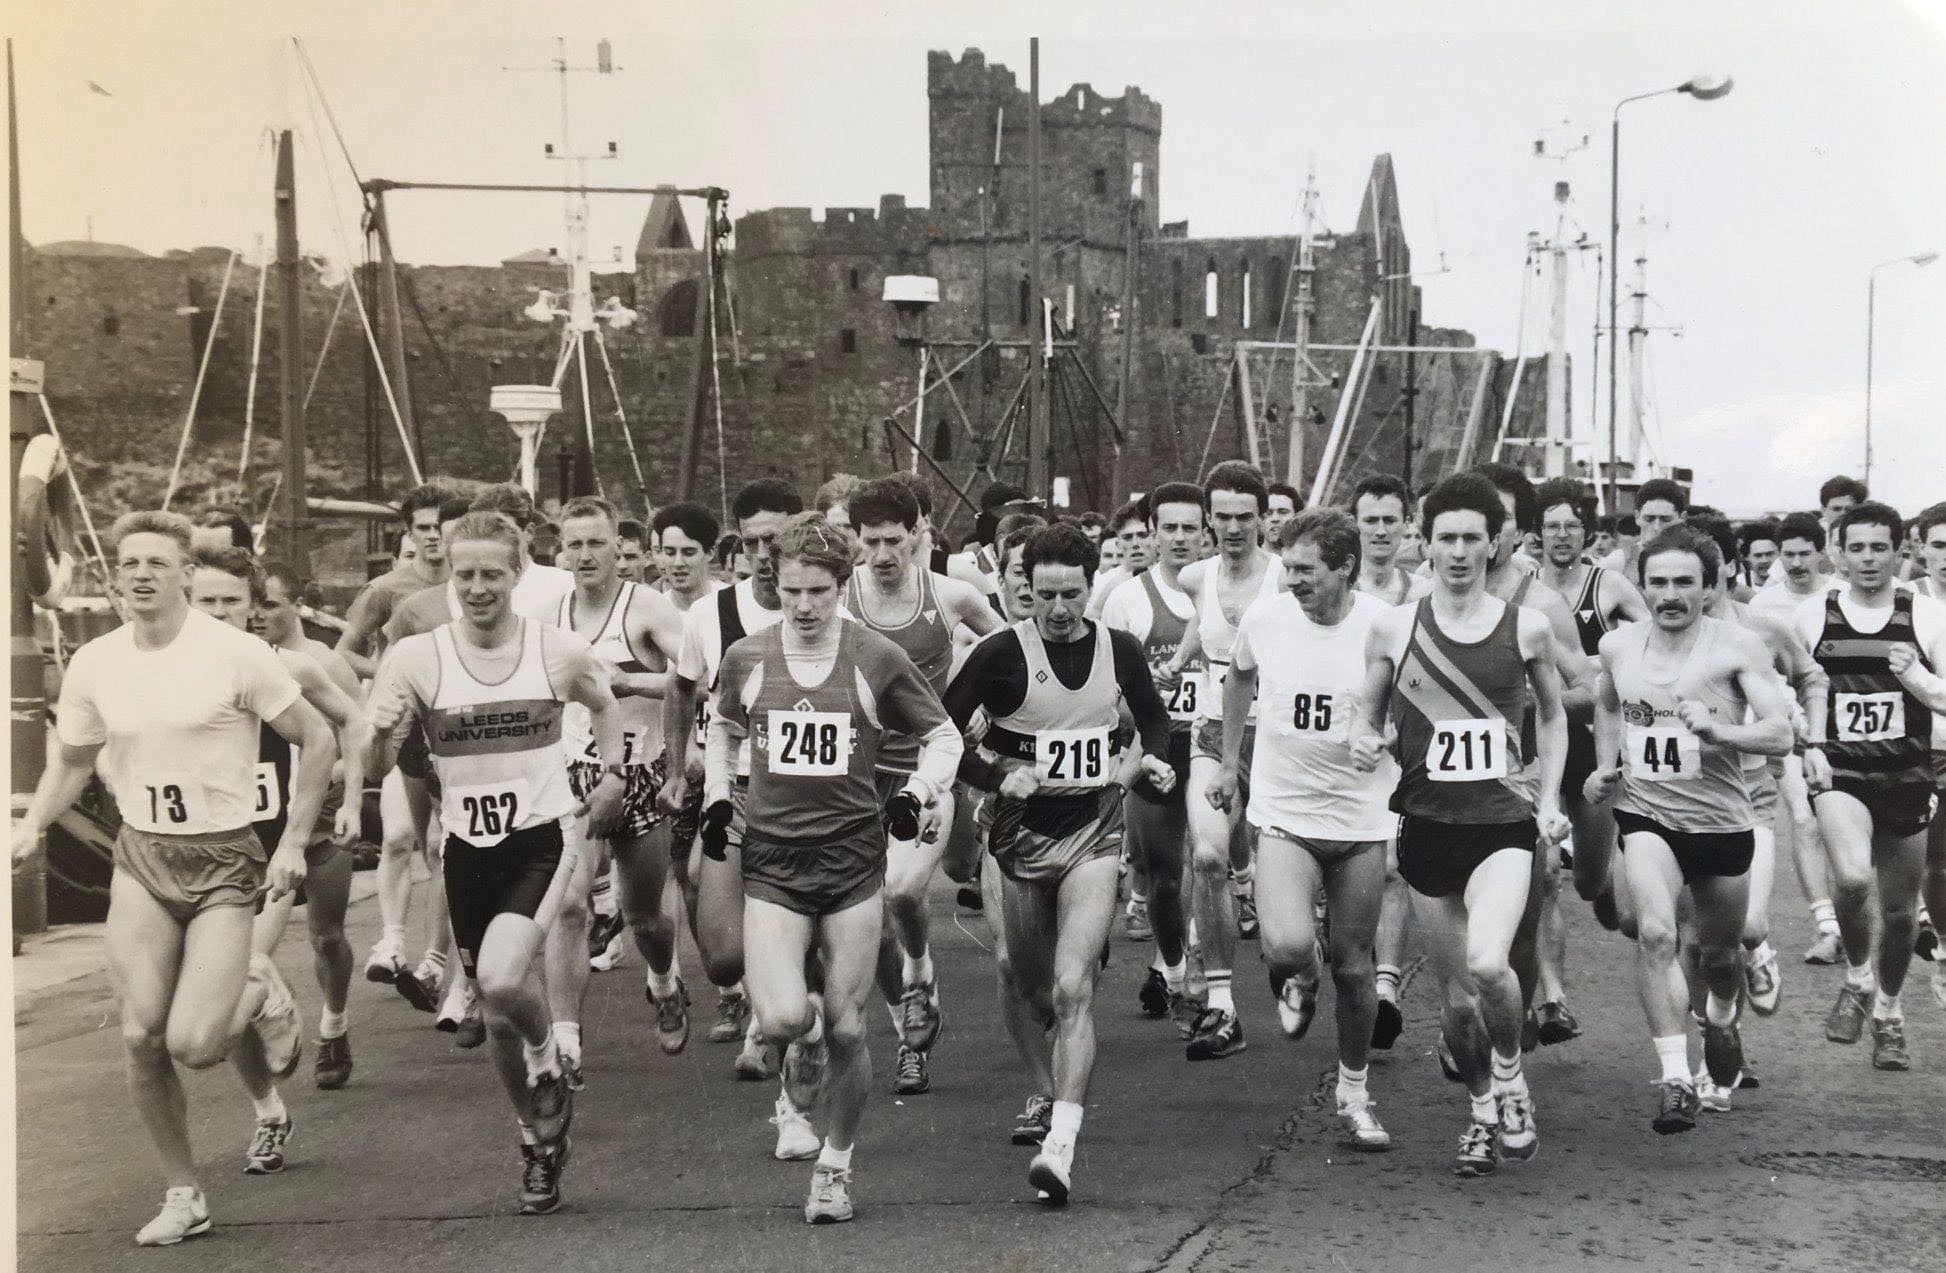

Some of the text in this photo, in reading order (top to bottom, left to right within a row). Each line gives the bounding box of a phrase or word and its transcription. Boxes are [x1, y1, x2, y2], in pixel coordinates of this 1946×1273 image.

[438, 721, 552, 742] UNIVERSITY
[461, 711, 529, 727] LEEDS
[1293, 693, 1332, 732] 85
[1846, 701, 1895, 734] 257
[780, 721, 838, 766] 248
[1048, 738, 1101, 779] 219
[1438, 730, 1492, 771] 211
[1644, 736, 1681, 773] 44
[145, 785, 187, 823] 13
[462, 781, 518, 836] 262
